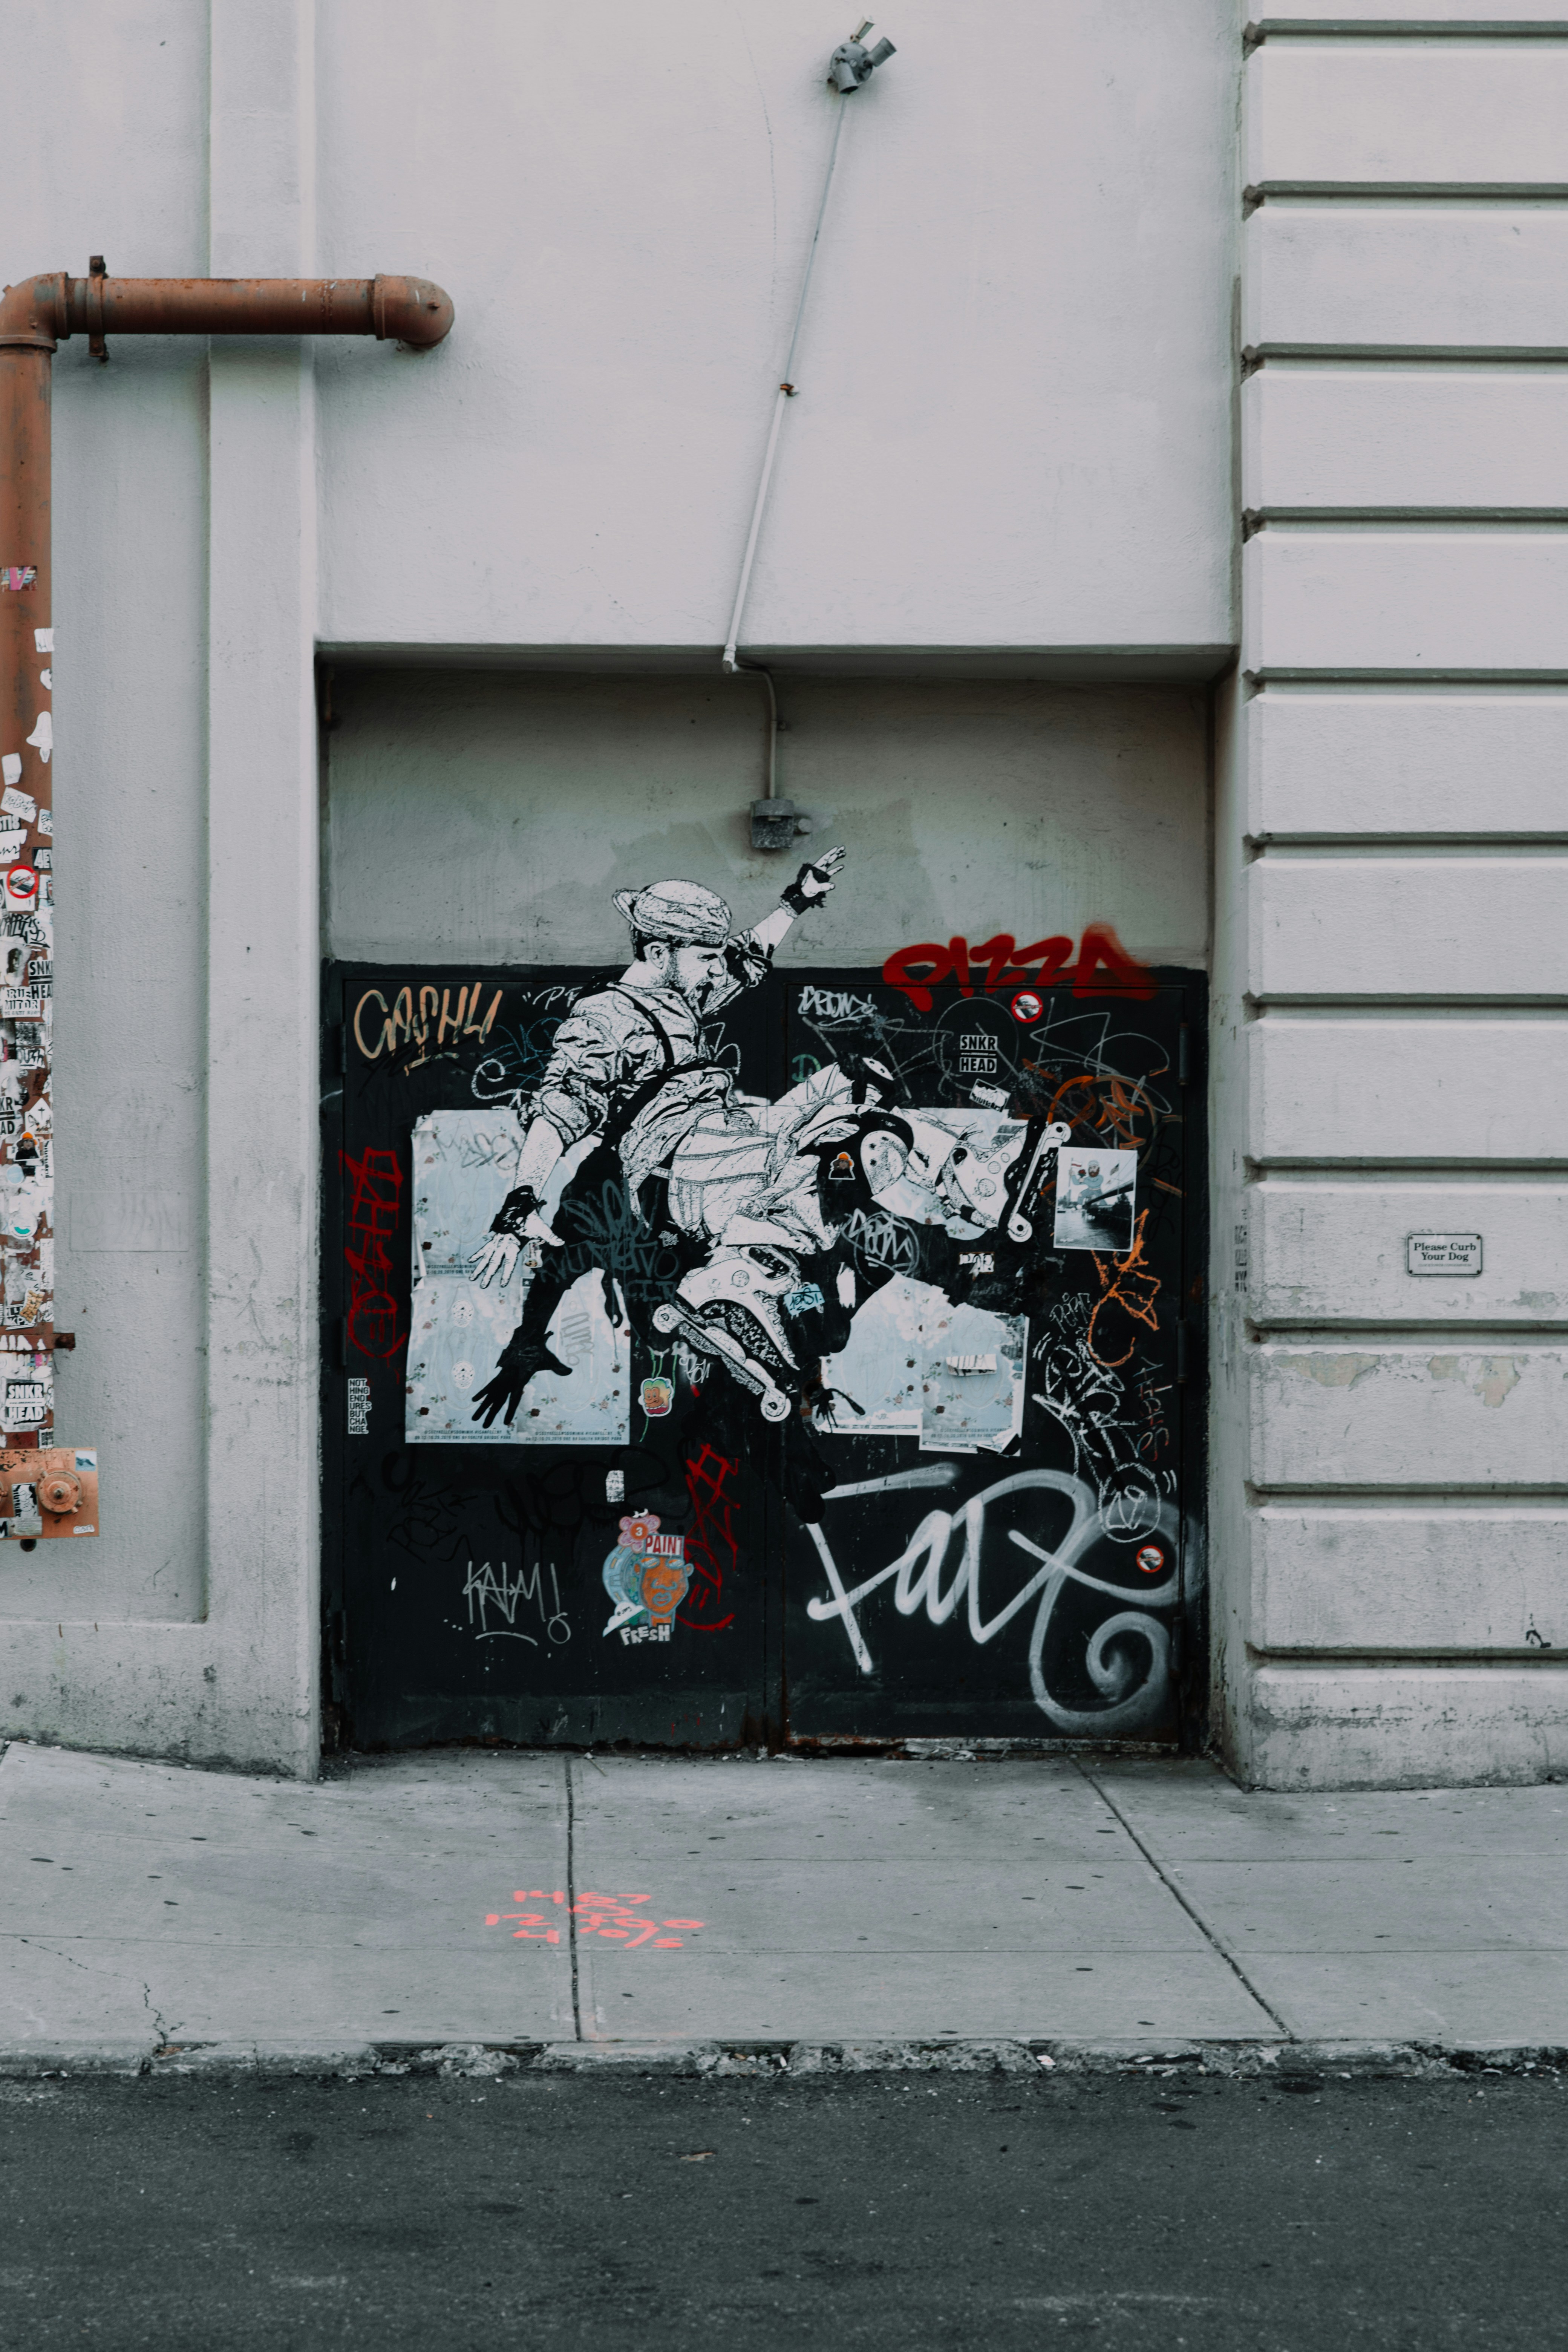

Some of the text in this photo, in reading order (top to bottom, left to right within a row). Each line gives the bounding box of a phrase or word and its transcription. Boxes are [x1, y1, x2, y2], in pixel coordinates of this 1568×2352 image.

[29, 960, 52, 975] SNK
[962, 1036, 995, 1050] SNKR
[961, 1058, 995, 1072] HEAD
[1450, 1242, 1476, 1251] Curb
[1449, 1252, 1469, 1262] Dog
[8, 1384, 43, 1398] SNKR
[8, 1407, 44, 1421] HEAD
[635, 1527, 643, 1536] 3
[619, 1624, 671, 1646] FRESH
